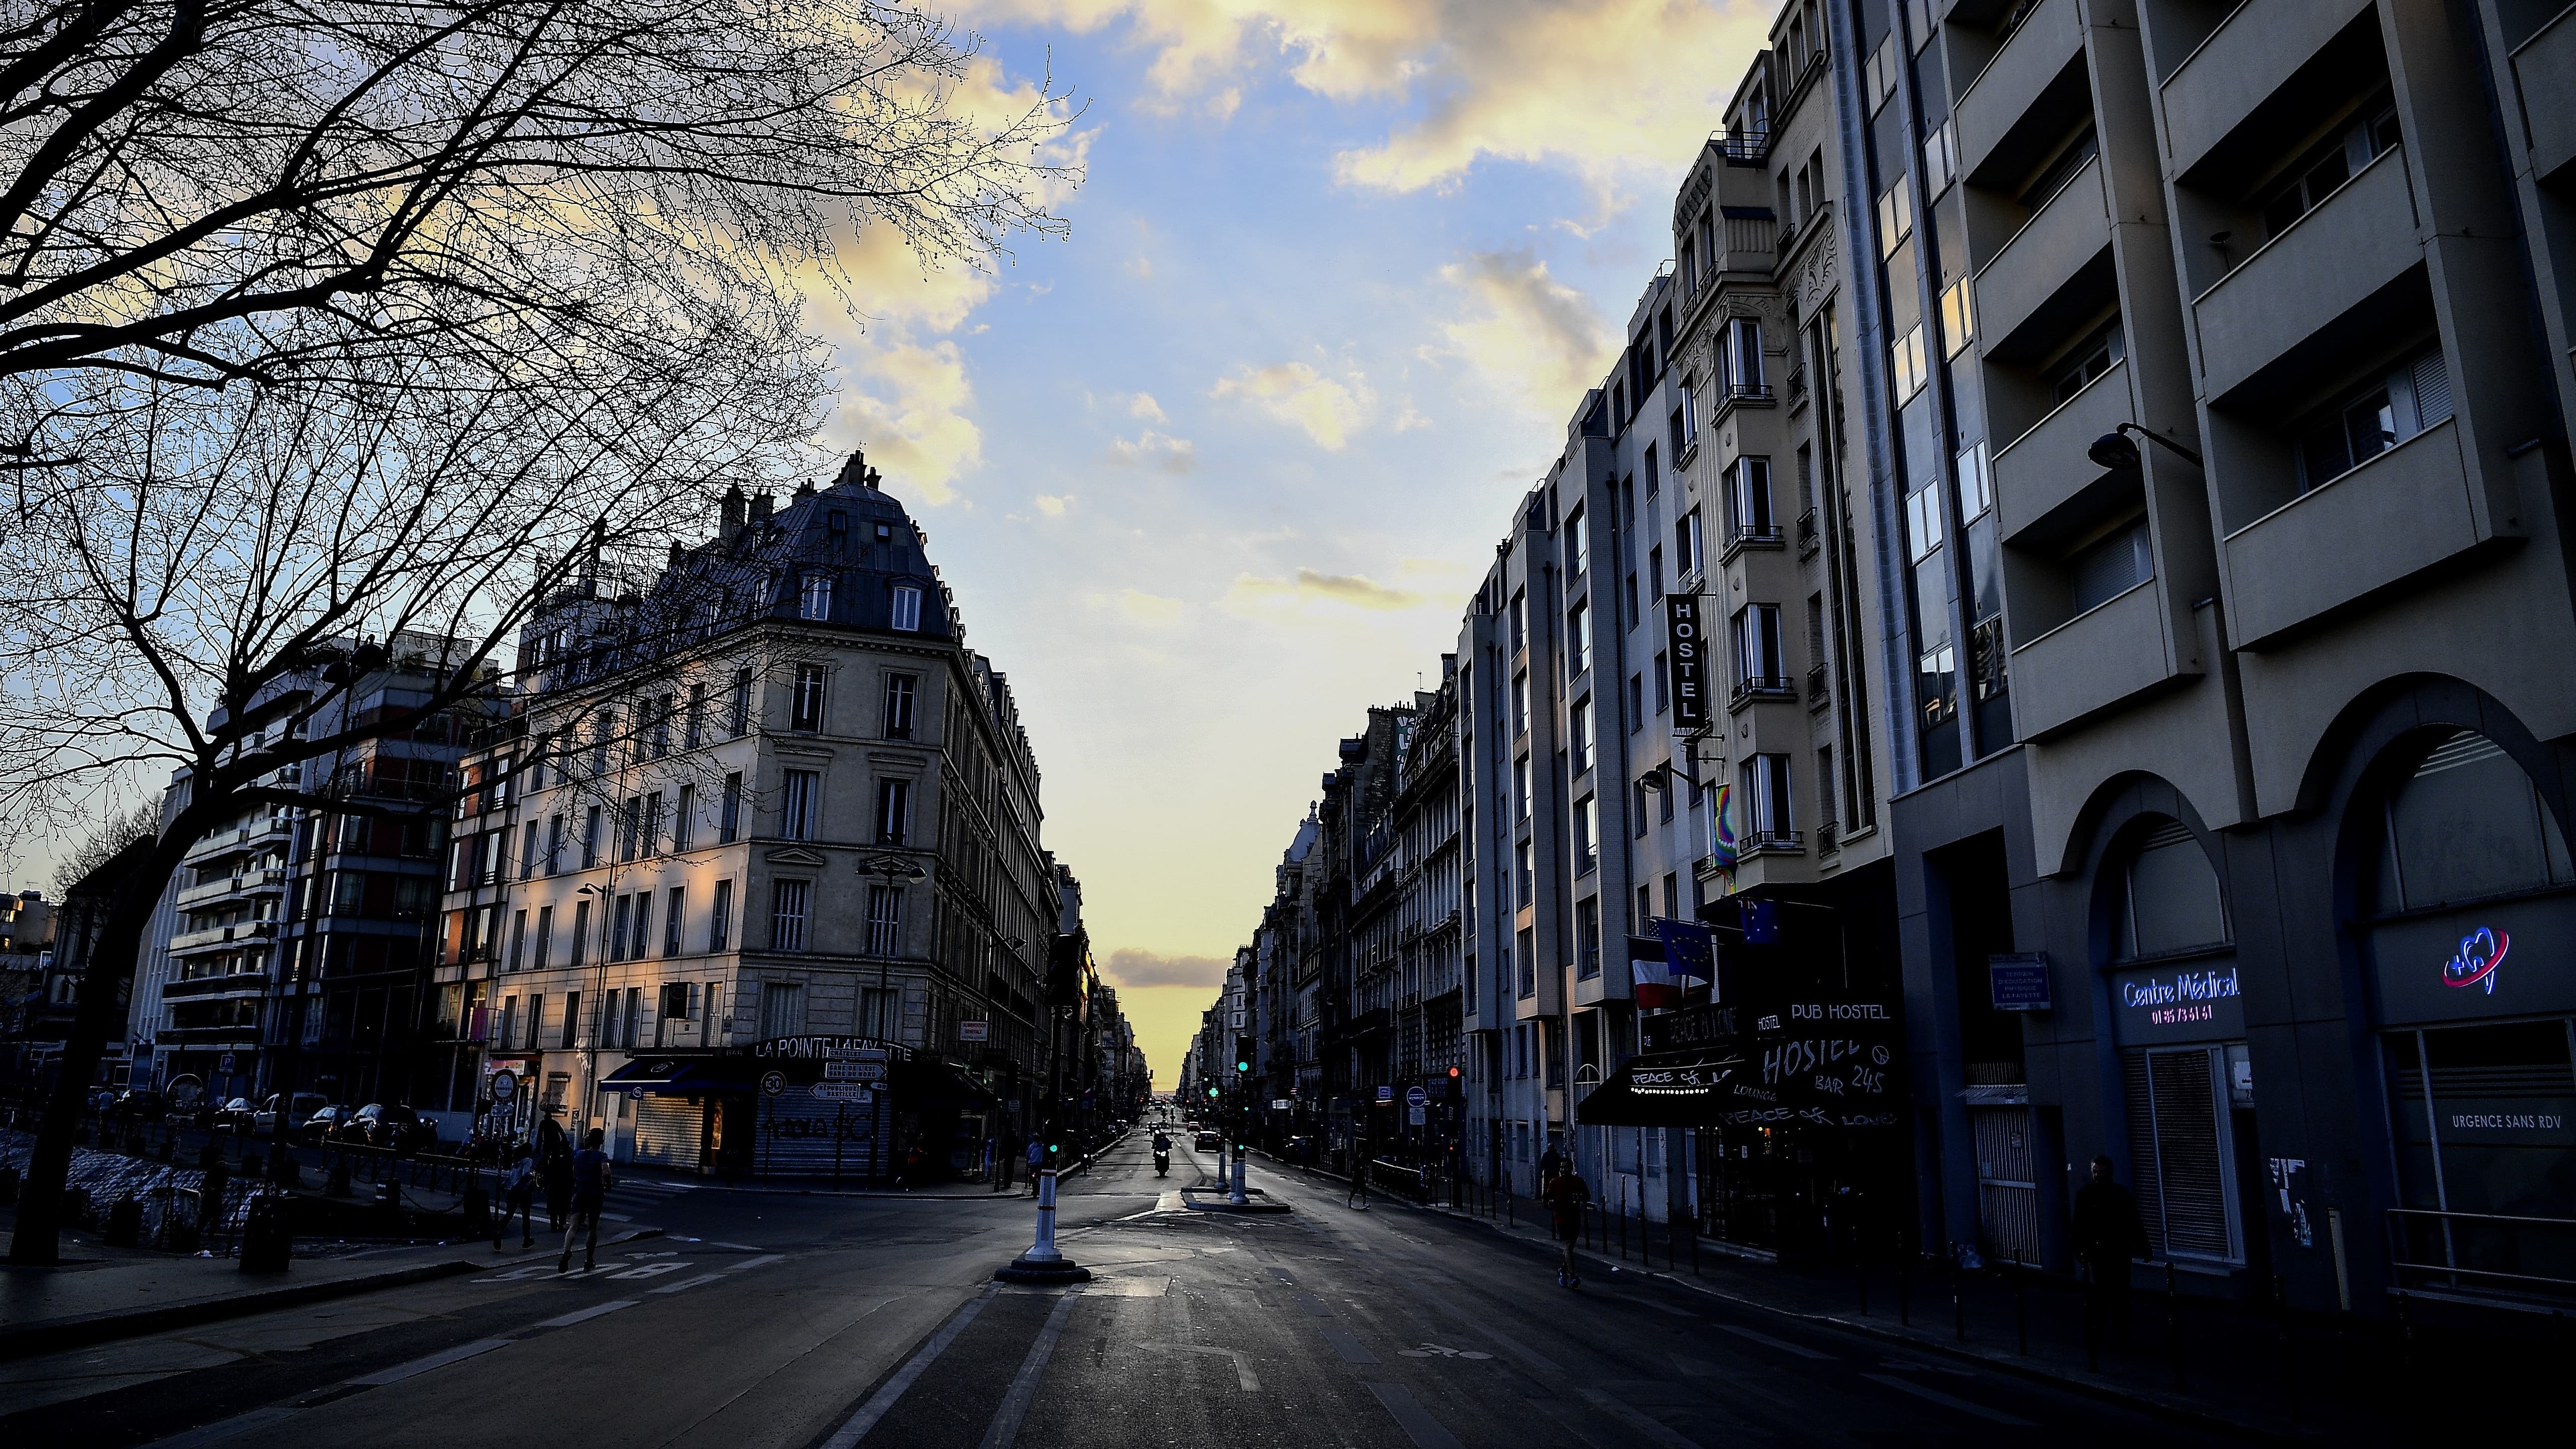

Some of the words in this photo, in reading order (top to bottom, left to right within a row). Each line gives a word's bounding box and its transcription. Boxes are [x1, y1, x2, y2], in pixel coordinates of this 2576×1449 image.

[1675, 604, 1696, 717] HOSTEL
[2124, 978, 2175, 1008] Centre
[2176, 968, 2240, 1002] Médical
[1791, 1004, 1822, 1019] PUB
[1828, 1004, 1891, 1019] HOSTEL
[2151, 1010, 2162, 1024] 01
[1757, 1015, 1781, 1031] HOSTEL
[756, 1042, 774, 1057] LA
[778, 1038, 832, 1059] POINTE
[766, 1079, 781, 1090] 30
[1632, 1072, 1674, 1084] PEACE
[1815, 1075, 1845, 1097] BAR
[1733, 1084, 1777, 1101] LOUNGE
[1719, 1107, 1795, 1125] PEACE
[2452, 1115, 2502, 1128] URGENCE
[2505, 1115, 2535, 1129] SANS
[2538, 1115, 2560, 1129] RDV
